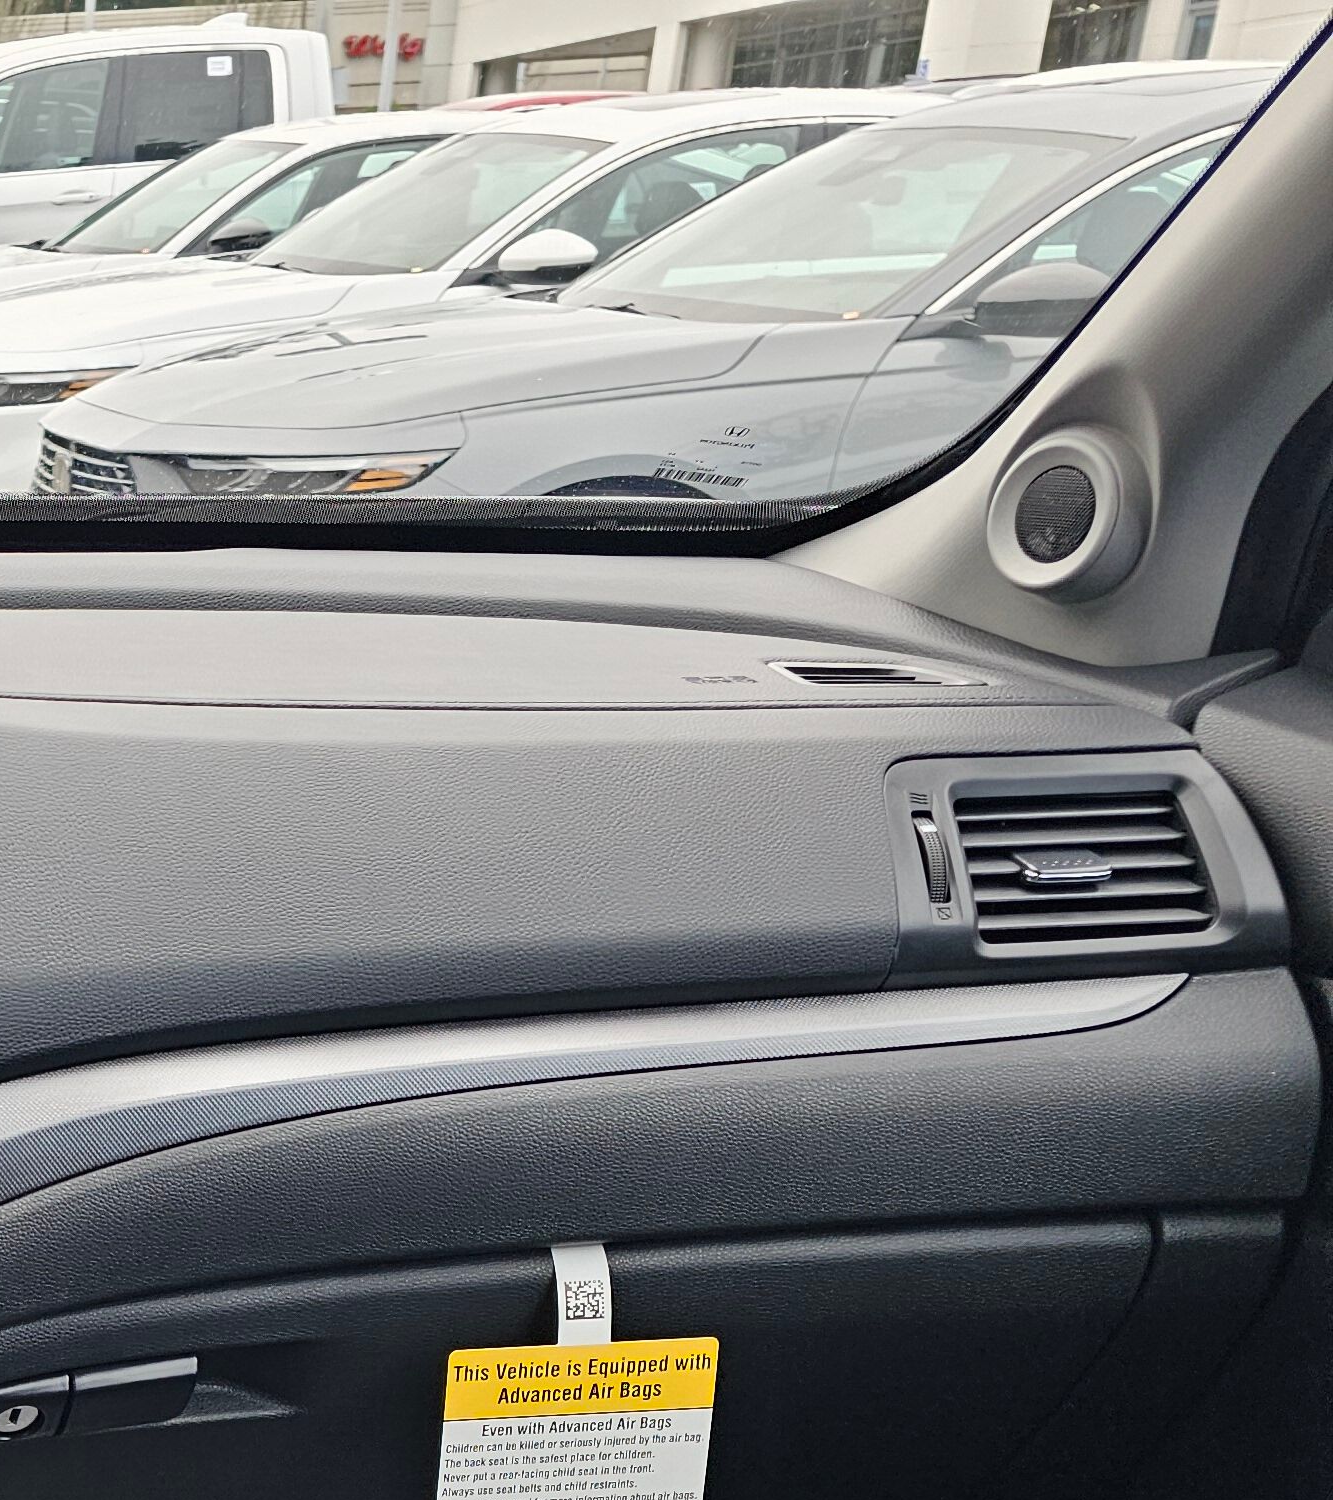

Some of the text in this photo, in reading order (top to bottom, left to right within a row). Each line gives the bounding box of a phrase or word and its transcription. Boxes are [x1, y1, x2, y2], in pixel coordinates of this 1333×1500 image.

[454, 1353, 711, 1382] This Vehicle is Equipped with
[497, 1381, 662, 1404] Advanced Air Bags
[482, 1416, 672, 1437] Even with Advanced Air Bags
[446, 1432, 704, 1454] Children can be killed or seriously injured by the air bag.
[441, 1479, 638, 1498] Always use seat belts and child restraints.
[657, 1491, 670, 1500] air
[673, 1490, 697, 1500] bags.
